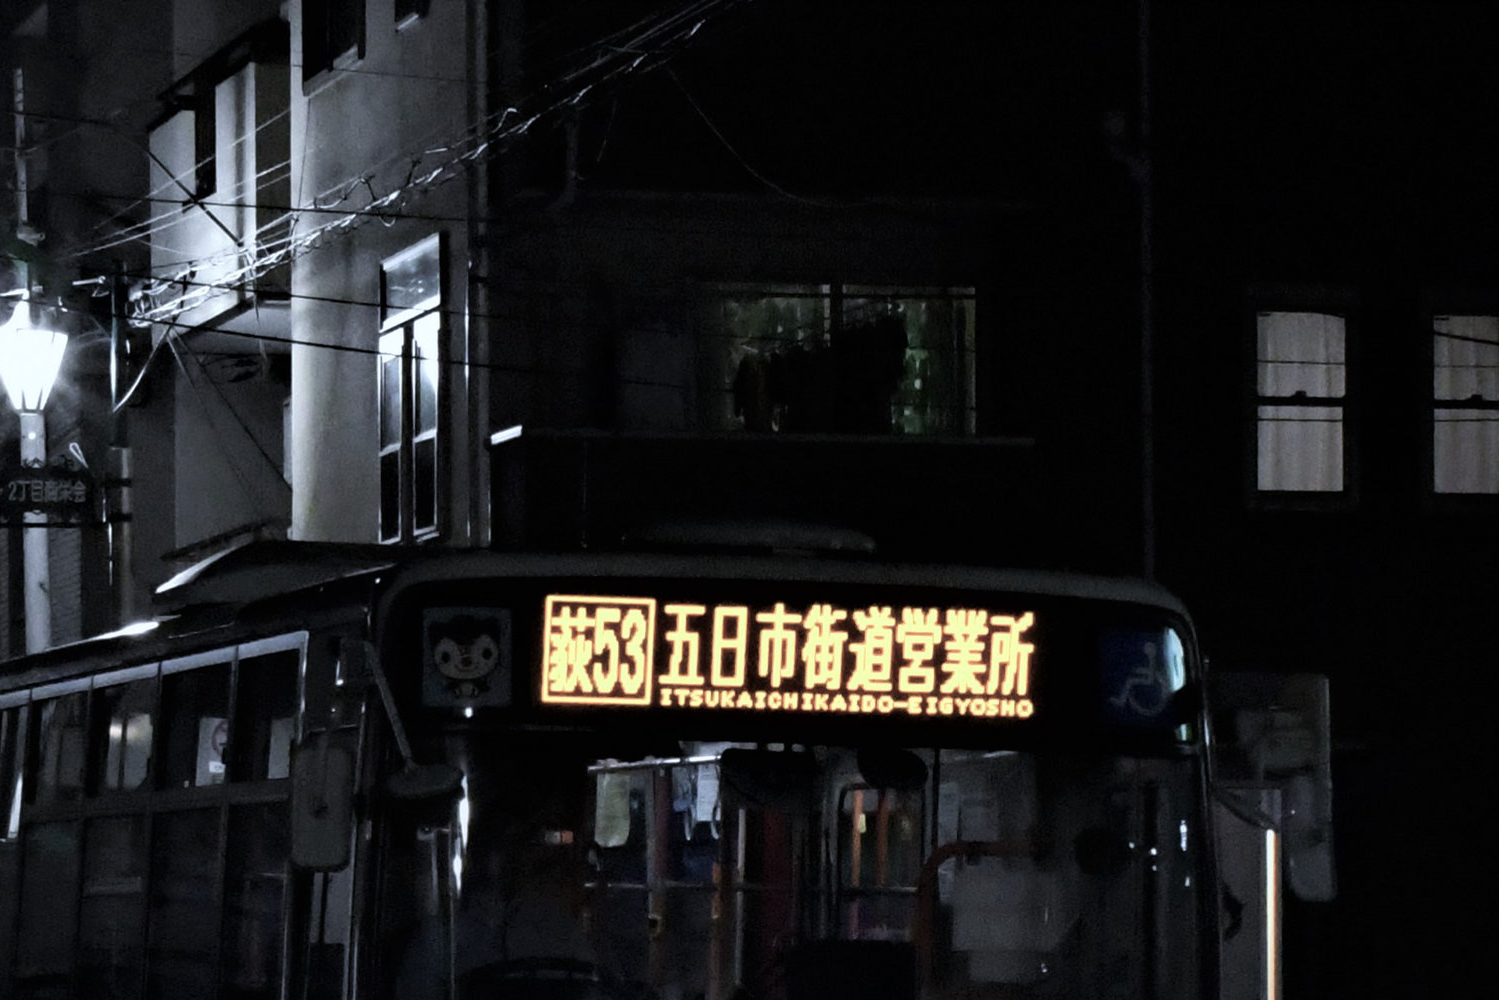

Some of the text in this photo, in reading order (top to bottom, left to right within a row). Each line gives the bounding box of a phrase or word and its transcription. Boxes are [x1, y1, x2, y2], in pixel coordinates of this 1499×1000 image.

[658, 602, 1035, 696] 五日市街道営業所
